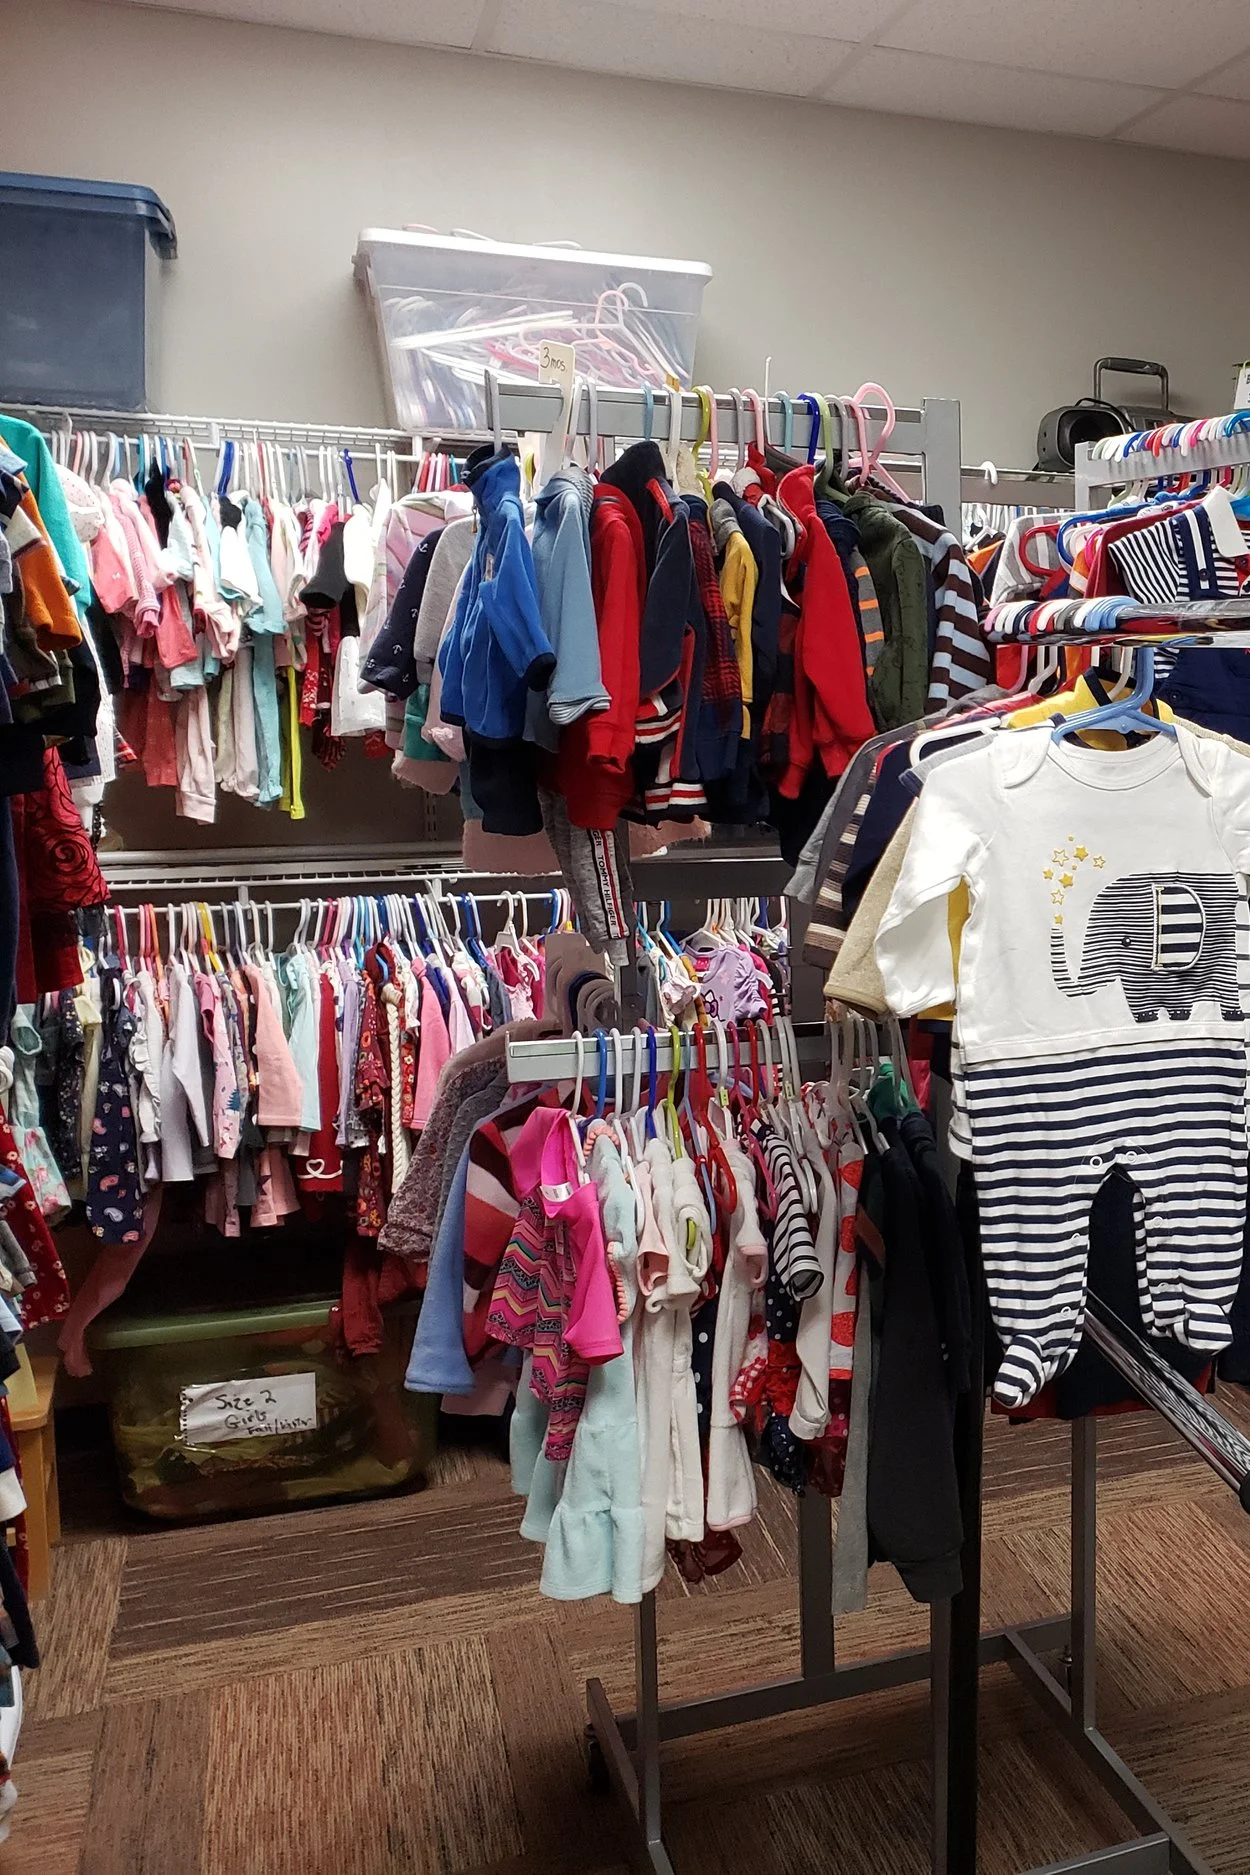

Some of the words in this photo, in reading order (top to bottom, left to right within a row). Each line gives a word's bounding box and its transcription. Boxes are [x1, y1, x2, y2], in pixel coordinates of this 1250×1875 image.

[598, 855, 609, 887] TOMMY
[603, 889, 616, 926] HILFIGER
[215, 1393, 254, 1410] Size
[260, 1390, 277, 1404] 2
[225, 1410, 267, 1429] Girls
